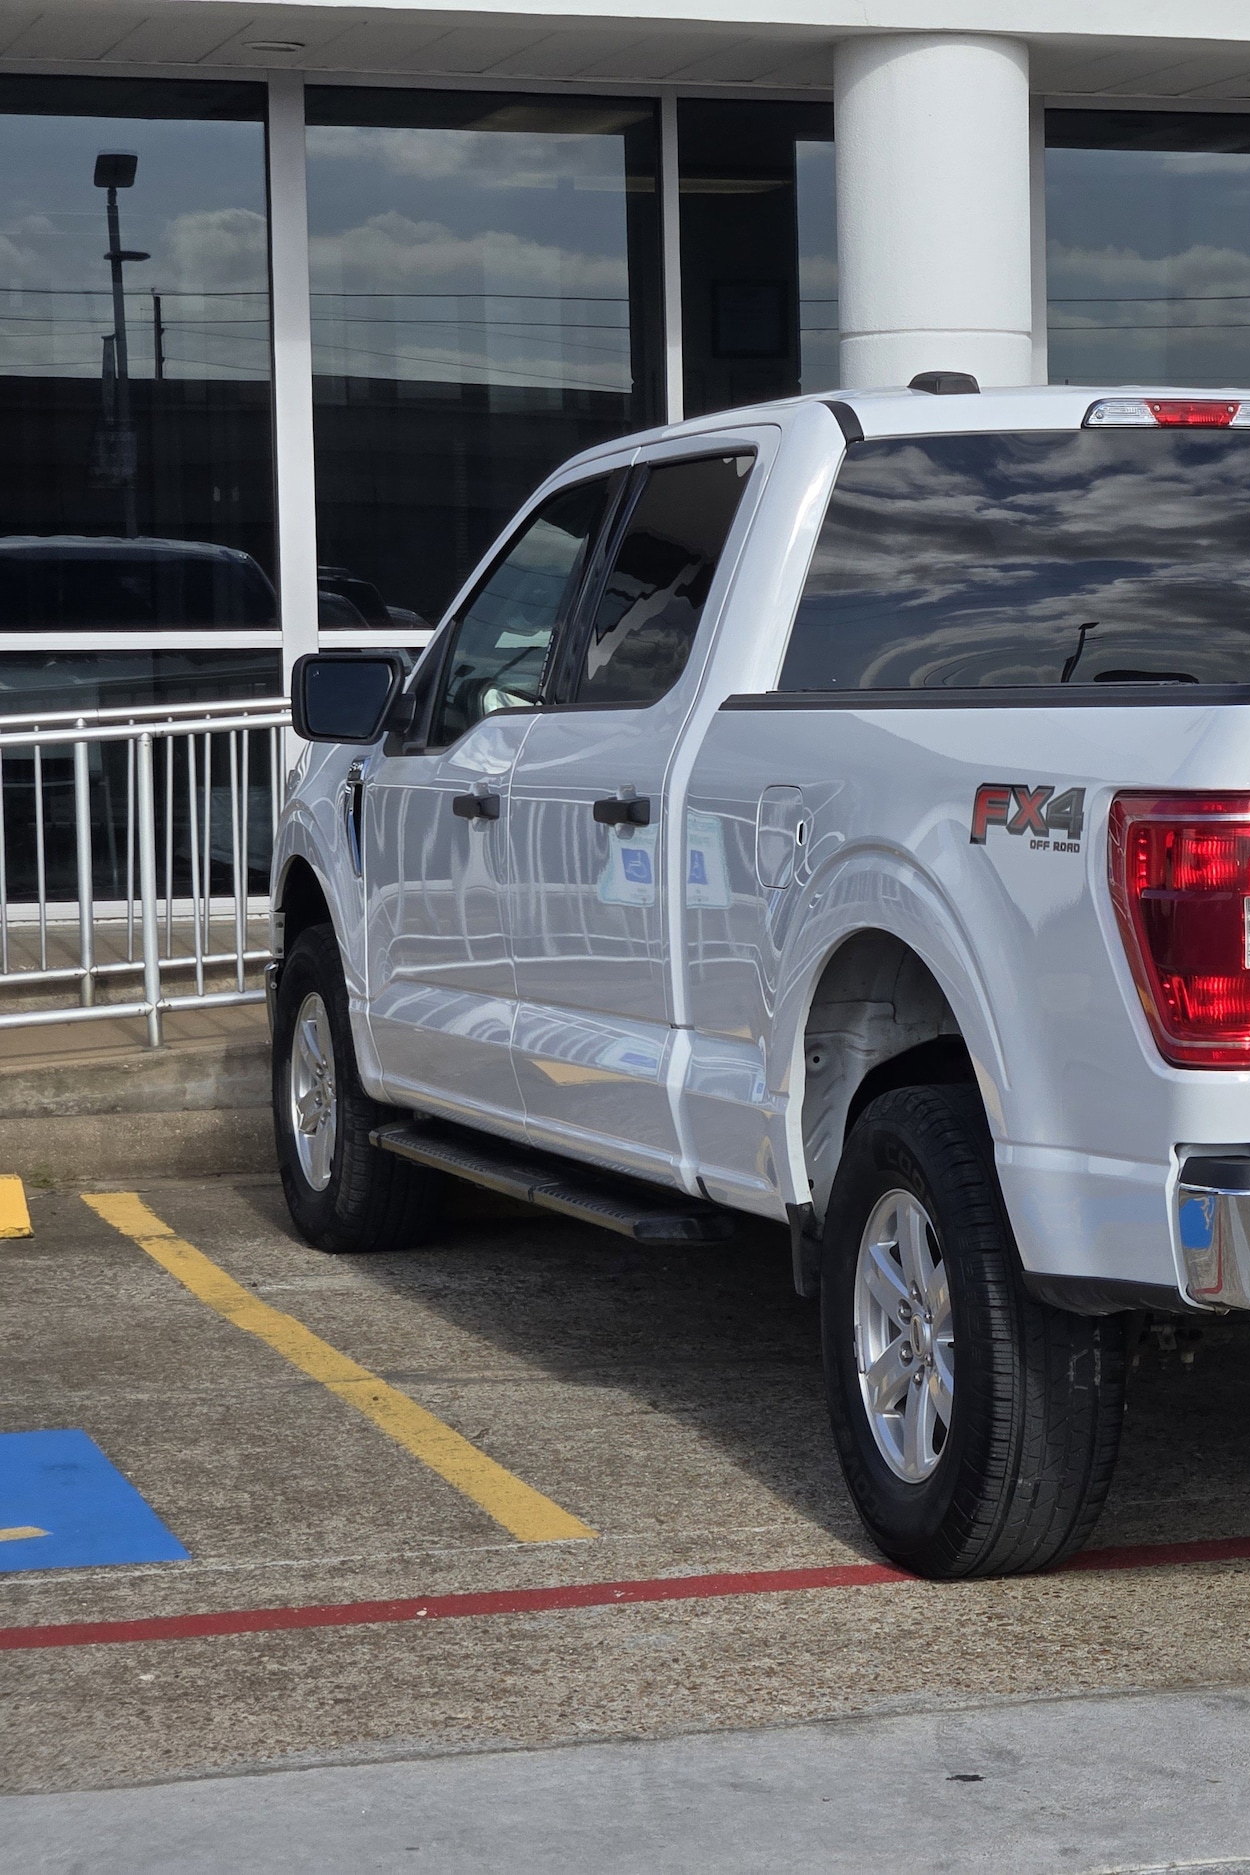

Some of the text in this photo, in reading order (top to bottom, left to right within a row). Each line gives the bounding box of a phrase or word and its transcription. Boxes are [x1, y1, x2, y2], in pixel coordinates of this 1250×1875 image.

[969, 782, 1087, 845] FX4
[1029, 839, 1081, 853] OFF ROAD
